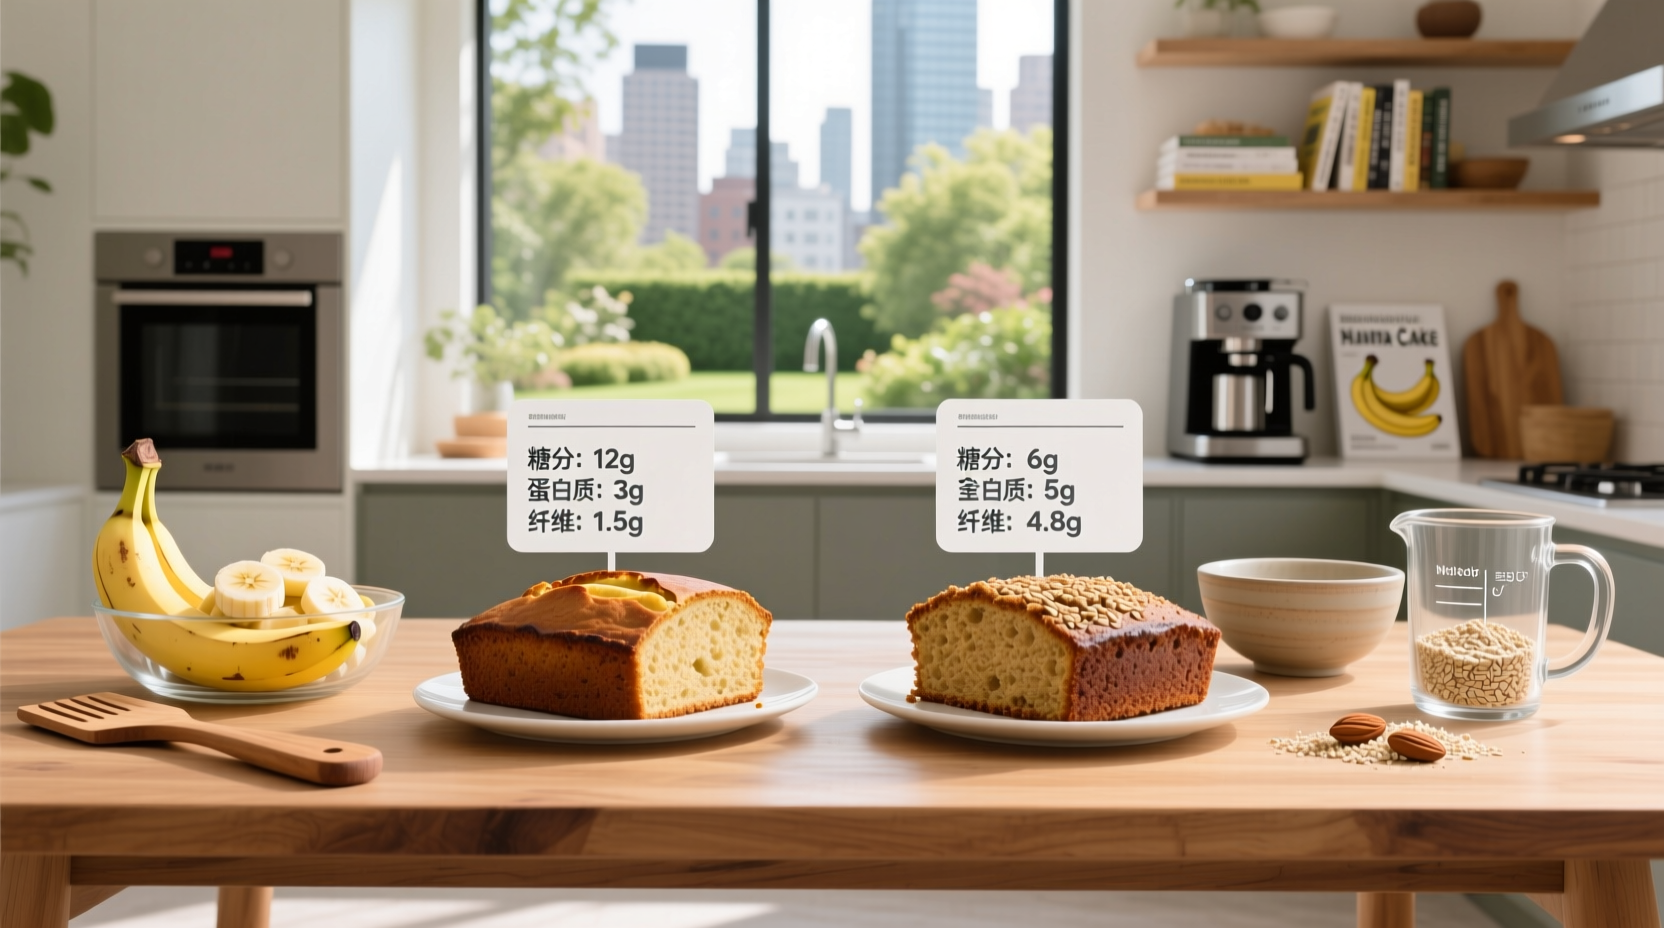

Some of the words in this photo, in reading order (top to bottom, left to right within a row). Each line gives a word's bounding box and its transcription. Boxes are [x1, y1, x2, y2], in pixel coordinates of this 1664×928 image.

[1397, 327, 1438, 346] CAKE
[527, 446, 582, 471] 糖分:
[593, 448, 635, 475] 12g
[1026, 448, 1058, 476] 6g
[527, 477, 602, 502] 蛋白质:
[613, 479, 644, 506] 3g
[1044, 479, 1075, 507] 5g
[528, 509, 582, 533] 纤维:
[593, 510, 643, 538] 1.5g
[957, 509, 1012, 534] 纤维:
[1026, 510, 1082, 538] 4.8g
